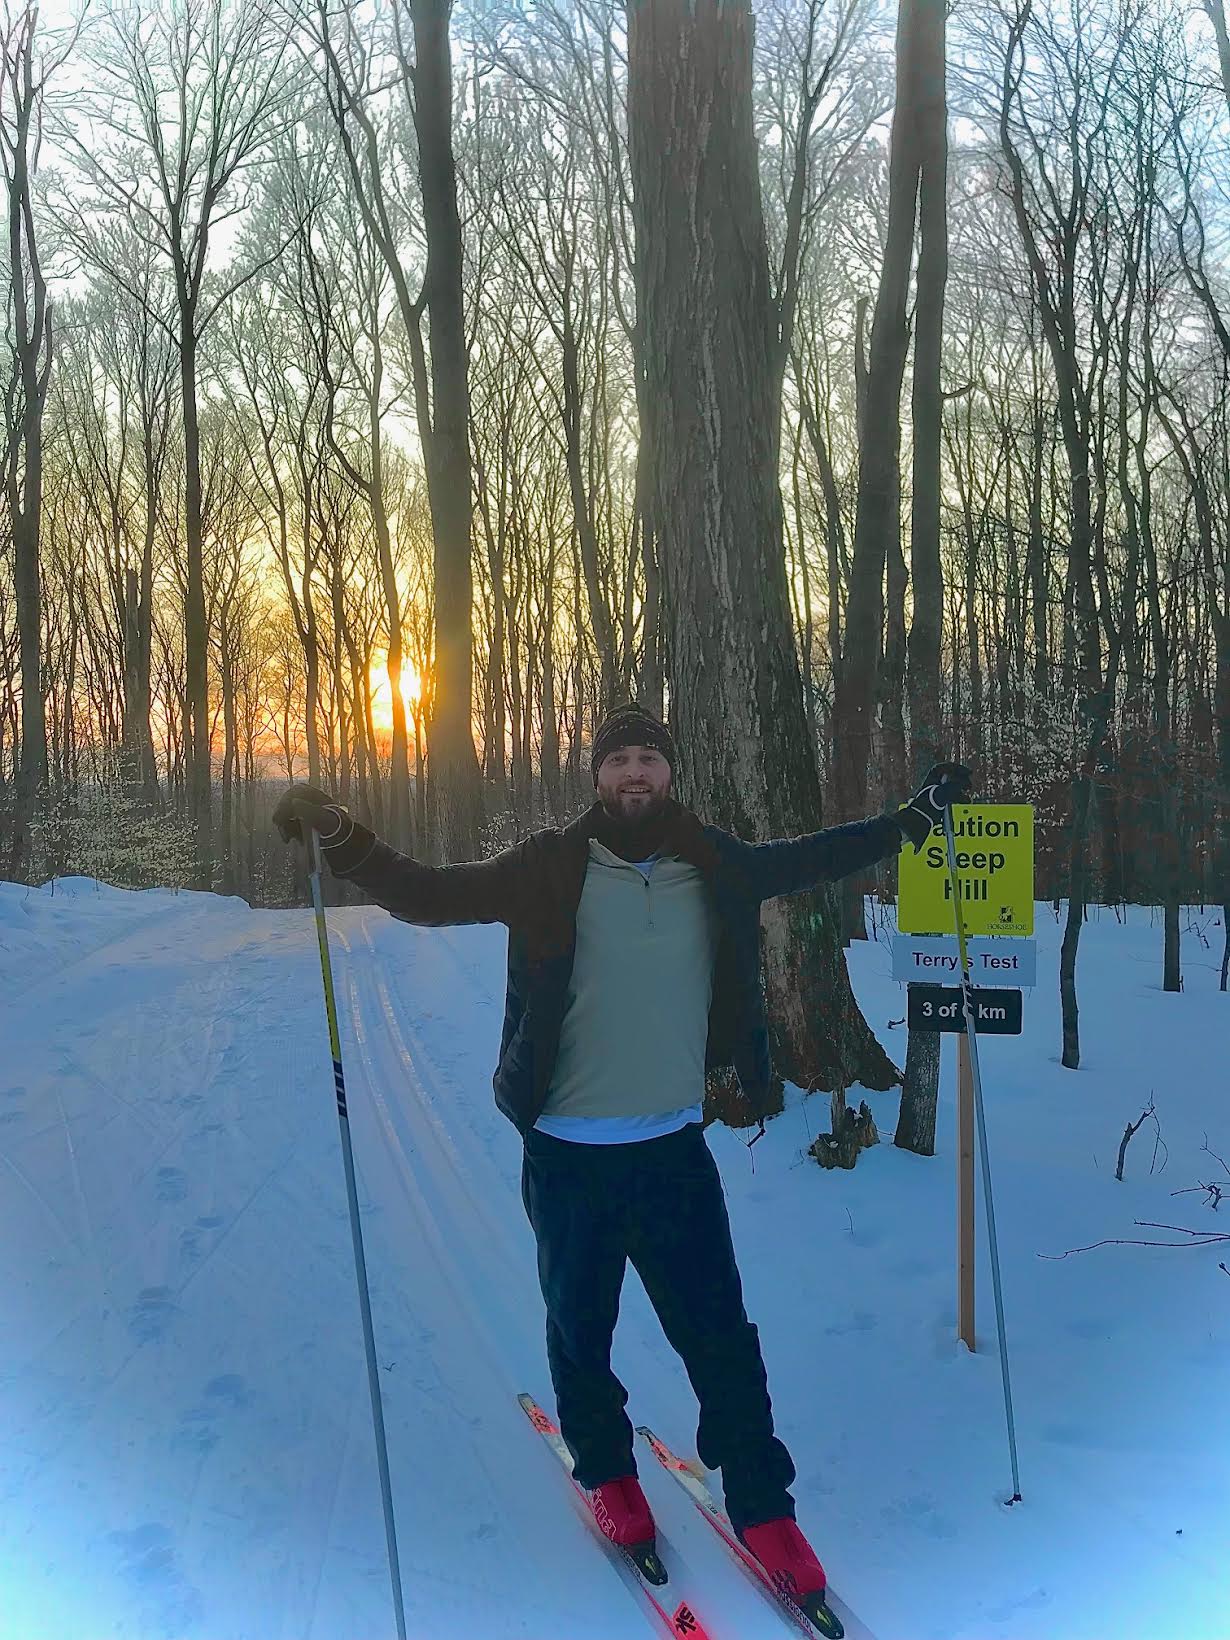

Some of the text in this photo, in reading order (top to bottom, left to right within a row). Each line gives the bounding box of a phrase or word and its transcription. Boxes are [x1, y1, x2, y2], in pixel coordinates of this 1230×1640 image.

[932, 815, 1019, 838] aution
[944, 879, 987, 900] Hill
[912, 952, 1019, 971] Terrys Test
[922, 1001, 933, 1017] 3
[938, 1002, 958, 1018] of
[978, 1003, 1006, 1019] km
